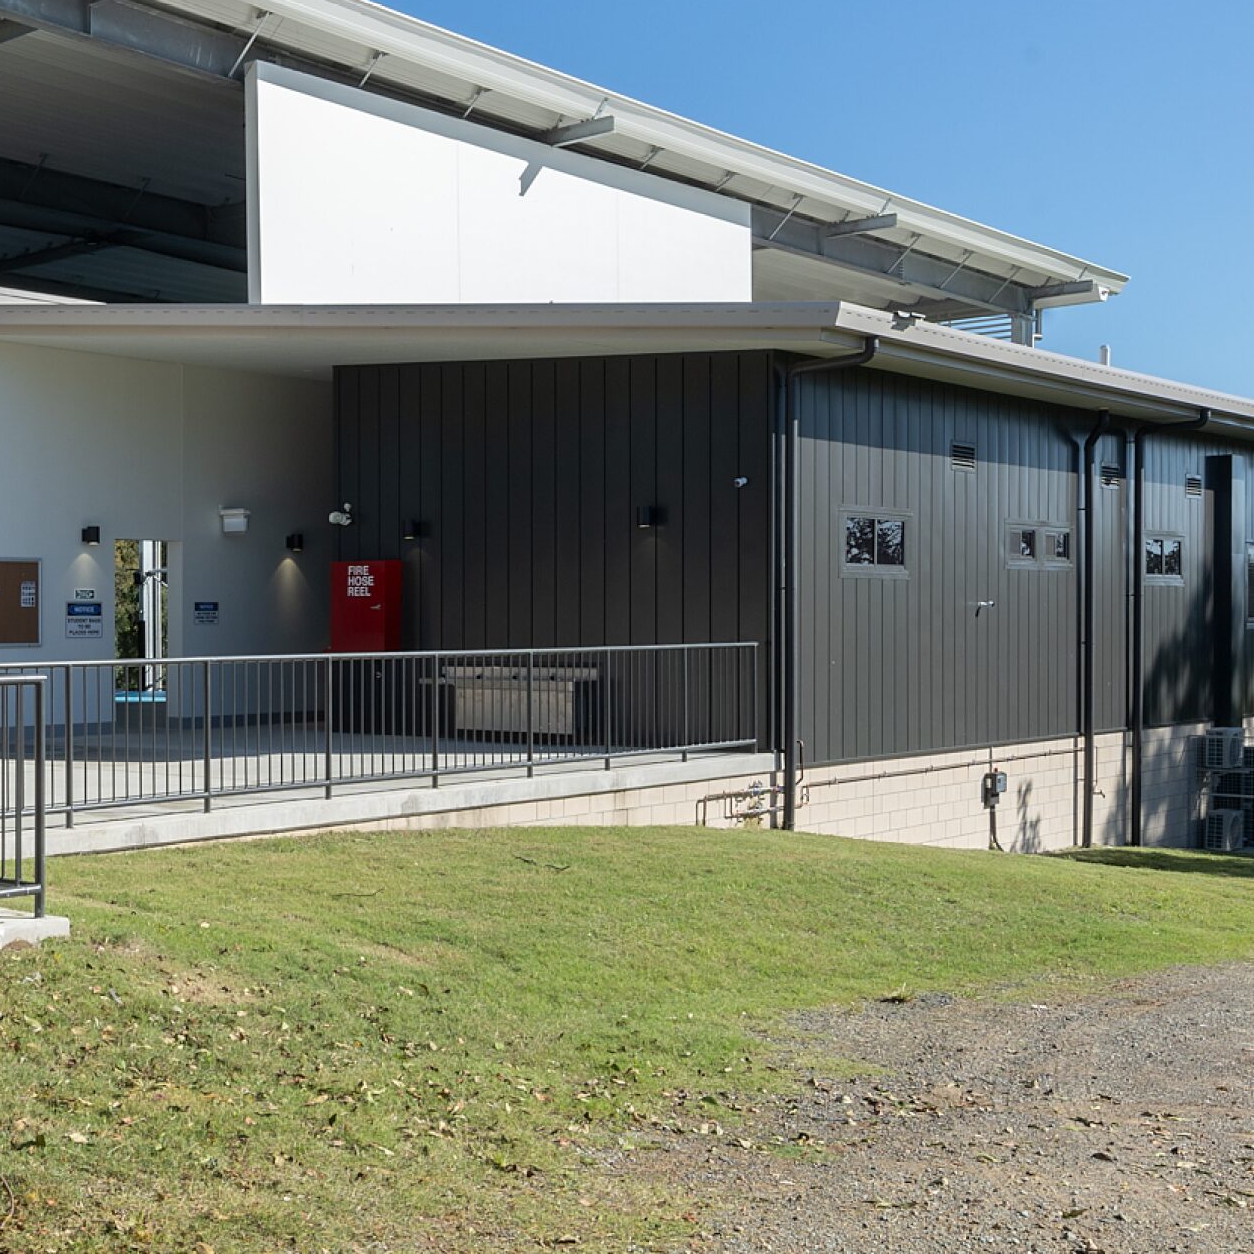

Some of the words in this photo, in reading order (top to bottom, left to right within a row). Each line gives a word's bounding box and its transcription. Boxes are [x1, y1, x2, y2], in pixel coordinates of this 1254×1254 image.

[348, 565, 369, 575] FIRE
[348, 576, 374, 586] HOSE
[347, 586, 371, 596] REEL
